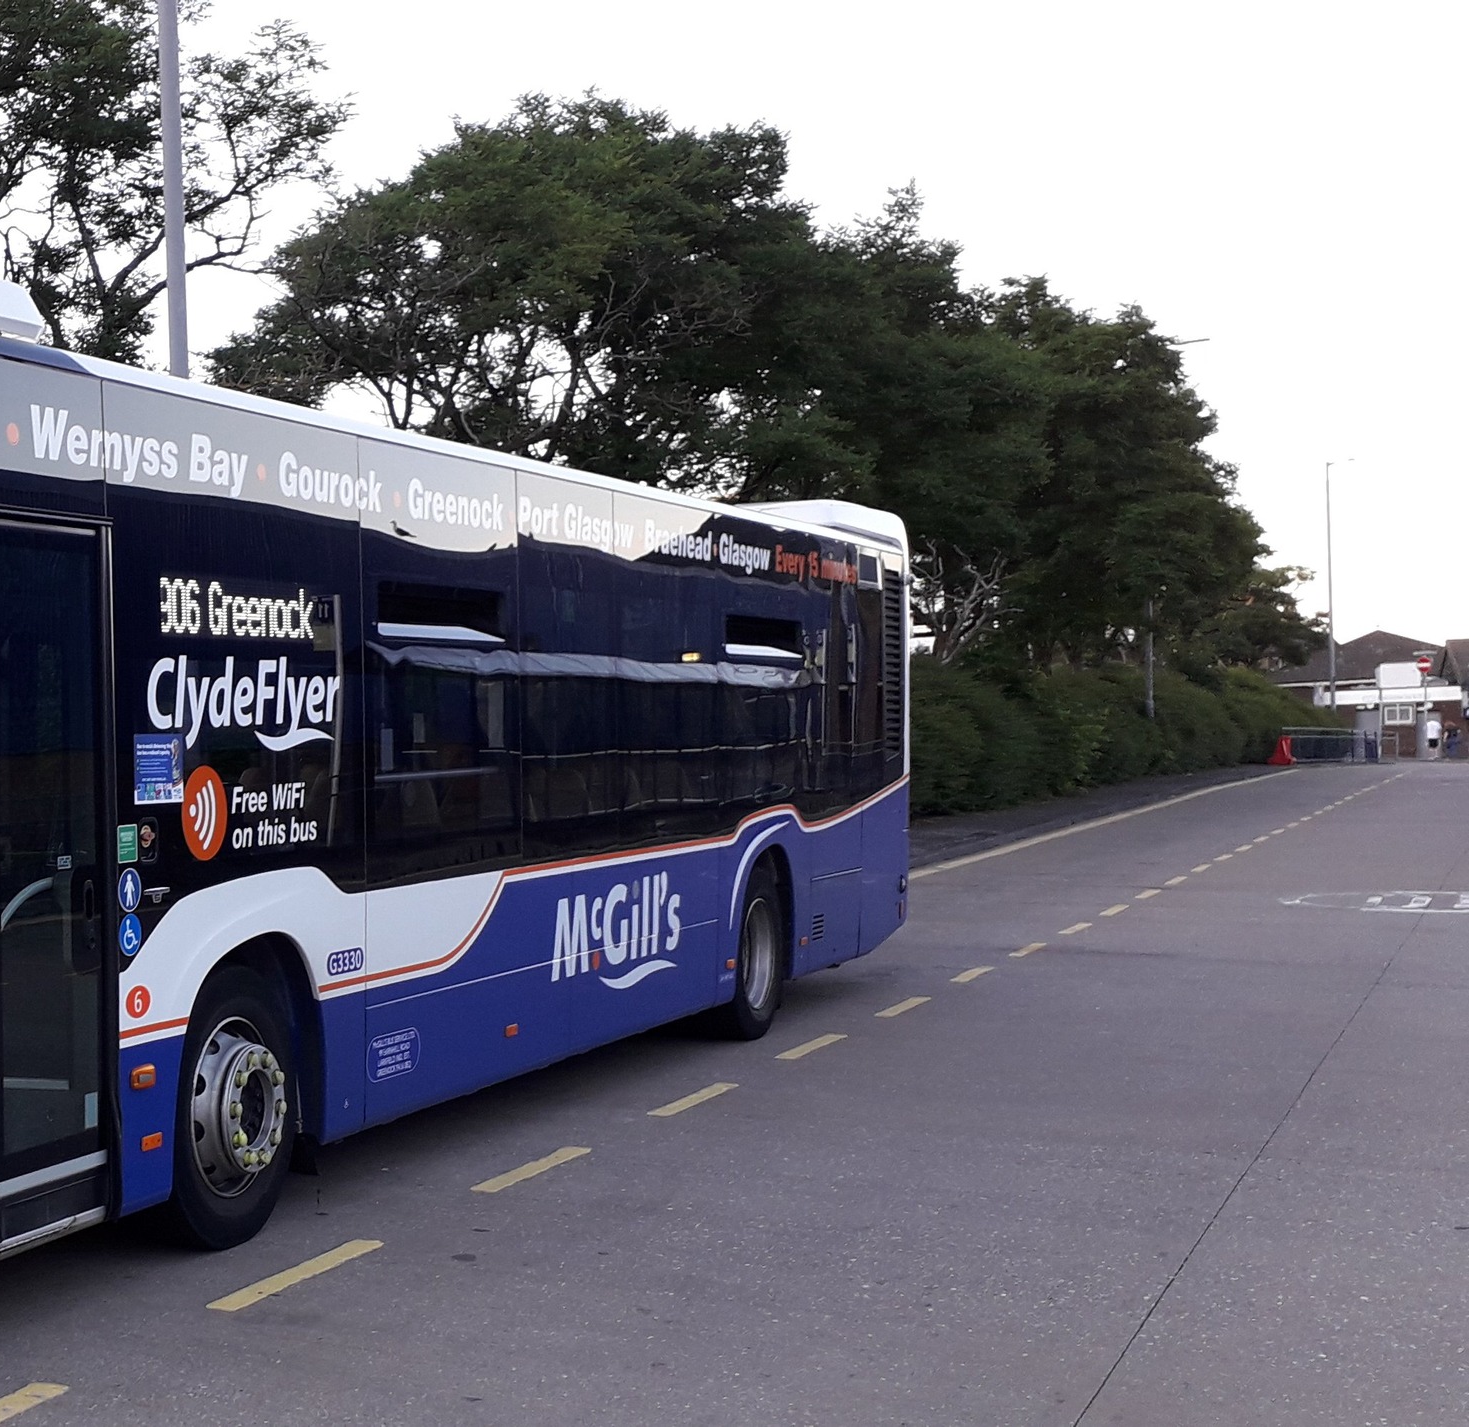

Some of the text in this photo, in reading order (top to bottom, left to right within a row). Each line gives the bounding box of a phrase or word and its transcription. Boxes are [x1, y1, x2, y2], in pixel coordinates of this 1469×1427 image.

[31, 404, 178, 484] Wemyss
[189, 434, 249, 498] Bay
[279, 451, 382, 512] Gourock
[407, 478, 504, 533] Greenock
[518, 495, 559, 536] Port
[564, 503, 634, 552] Glasgow
[644, 518, 713, 562] Braehead
[719, 532, 771, 576] Glasgow
[775, 544, 805, 583] Every
[208, 581, 314, 639] Greenock
[146, 654, 341, 752] ClydeFlyer
[232, 781, 306, 814] Free WiFi
[232, 817, 318, 850] on this bus
[329, 949, 363, 974] G3330
[132, 991, 143, 1013] 6
